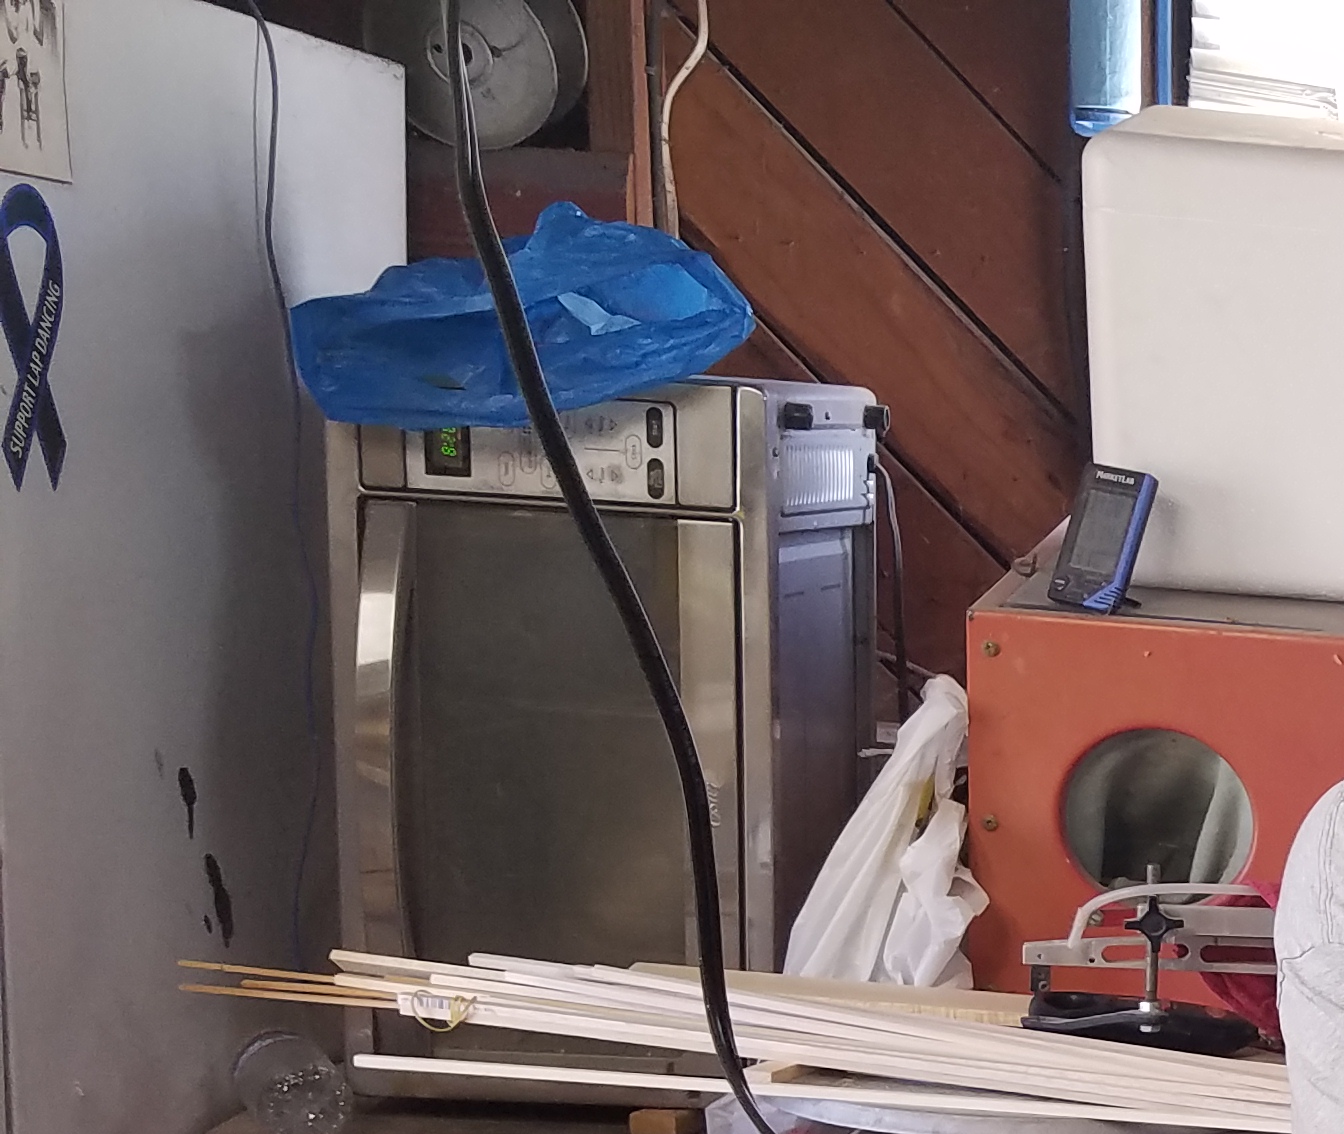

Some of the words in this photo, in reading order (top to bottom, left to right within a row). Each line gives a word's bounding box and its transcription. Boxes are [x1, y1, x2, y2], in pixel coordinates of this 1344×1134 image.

[33, 279, 61, 357] DANCING
[26, 351, 44, 388] LAP
[9, 382, 37, 460] SUPPORT
